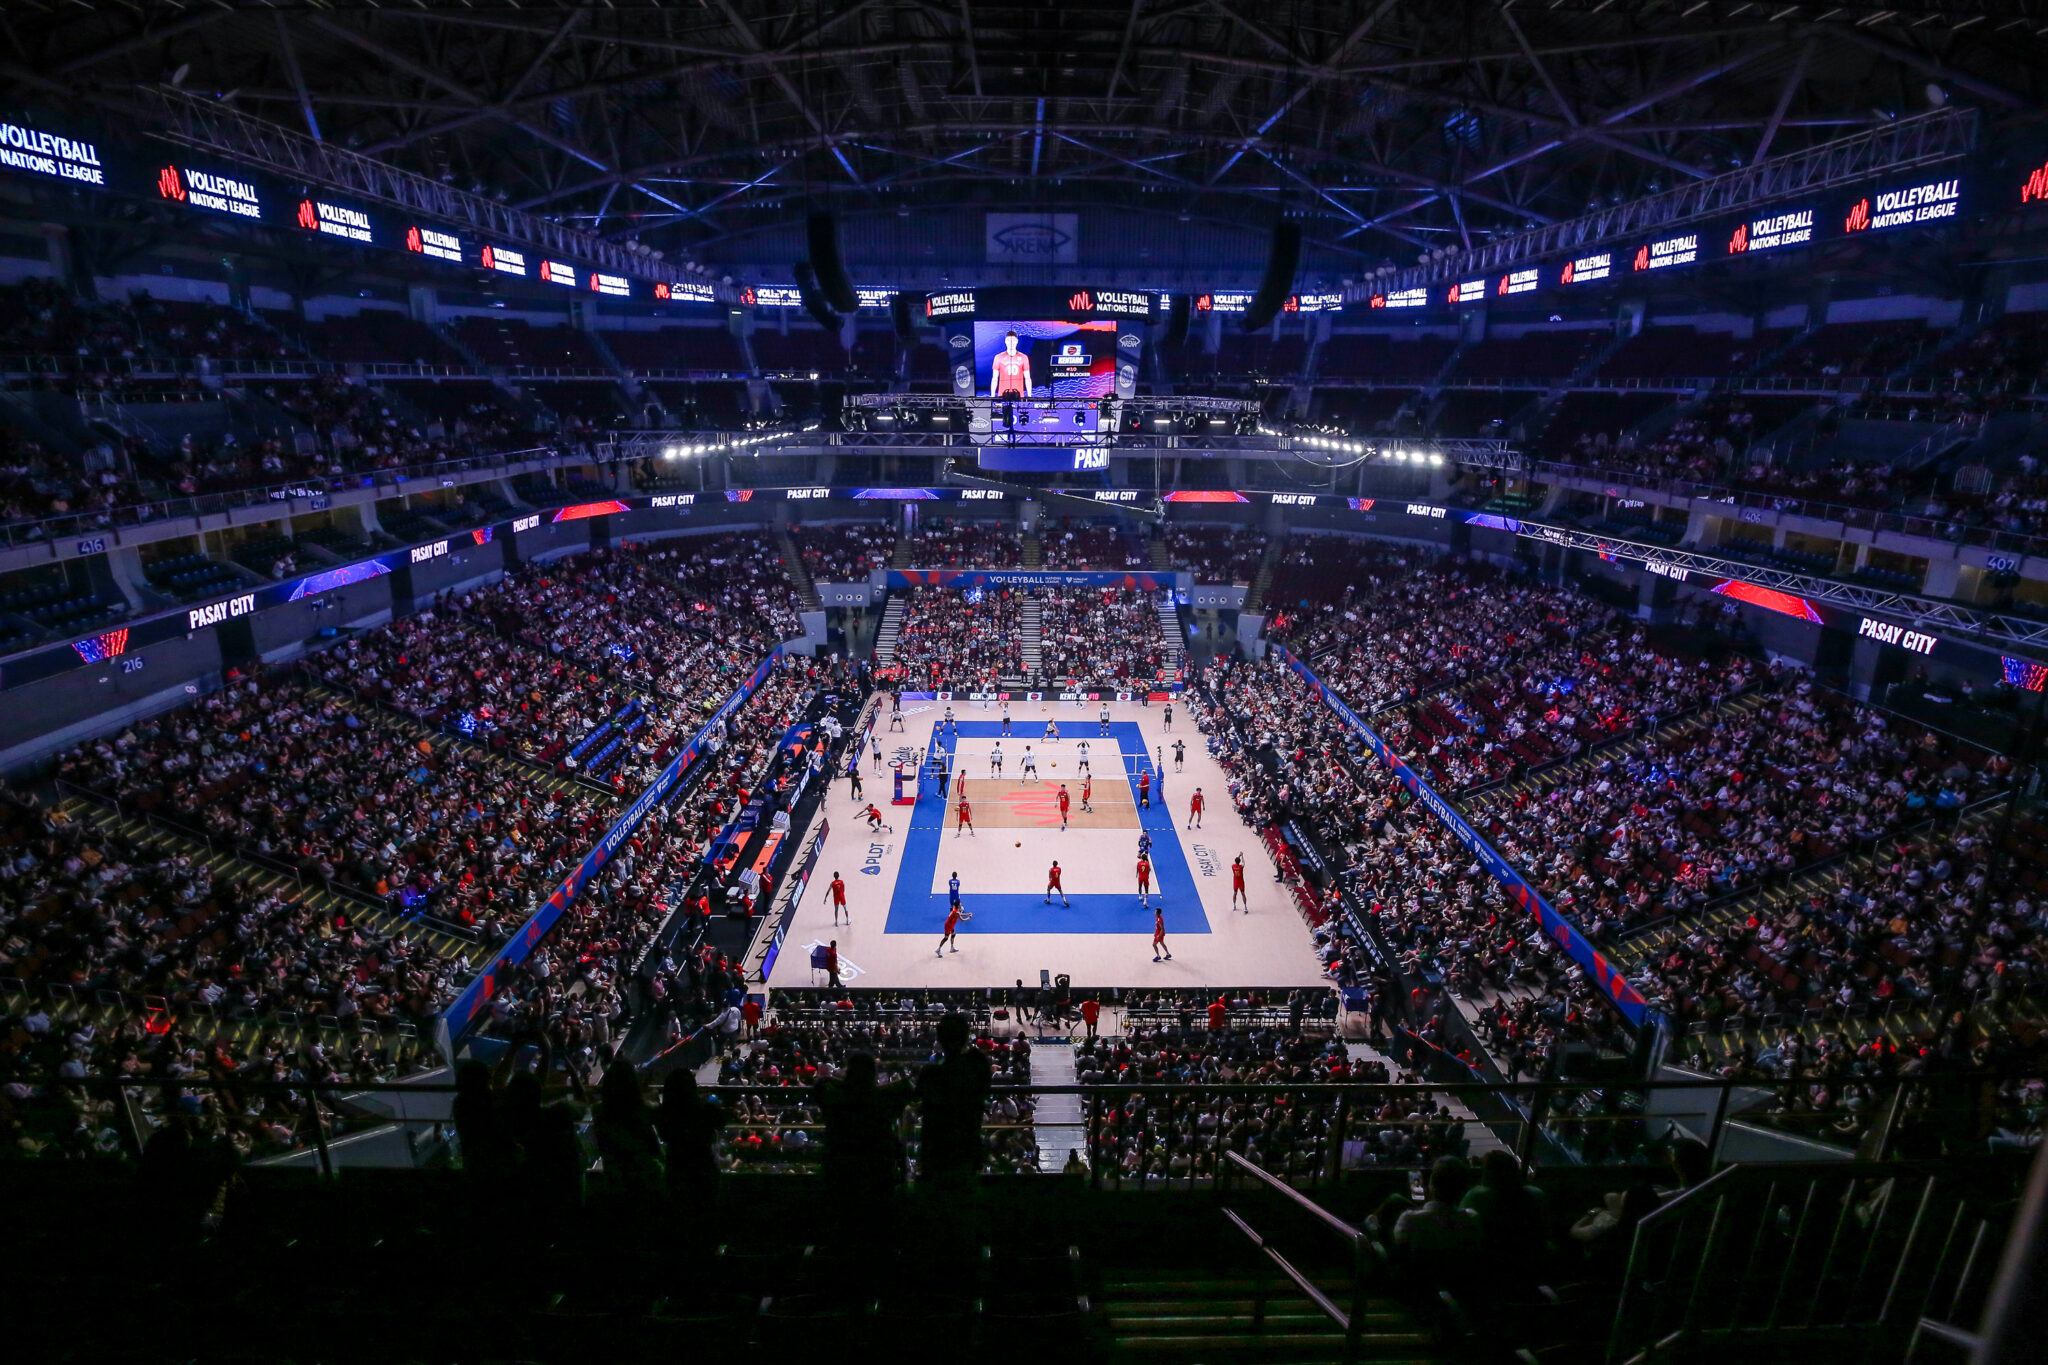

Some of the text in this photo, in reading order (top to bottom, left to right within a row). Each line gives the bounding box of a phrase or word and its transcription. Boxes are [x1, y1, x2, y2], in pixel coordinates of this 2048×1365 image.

[0, 123, 101, 166] VOLLEYBALL
[0, 148, 104, 185] NATIONS LEAGUE
[185, 169, 259, 202] VOLLEYBALL
[189, 191, 261, 218] NATIONS LEAGUE
[1876, 179, 1959, 213] VOLLEYBALL
[317, 202, 371, 229] VOLLEYBALL
[1752, 210, 1813, 237] VOLLEYBALL
[1871, 202, 1957, 229] NATIONS LEAGUE
[319, 221, 373, 242] NATIONS LEAGUE
[421, 229, 461, 251] VOLLEYBALL
[1749, 228, 1812, 251] NATIONS LEAGUE
[1652, 235, 1697, 256] VOLLEYBALL
[1575, 253, 1611, 272] VOLLEYBALL
[1649, 250, 1696, 269] NATIONS LEAGUE
[931, 292, 975, 306] VOLLEYBALL
[1096, 292, 1149, 306] VOLLEYBALL
[1096, 303, 1149, 315] NATIONS LEAGUE
[931, 304, 975, 315] NATIONS LEAGUE
[651, 494, 695, 508] PASAY CITY
[787, 488, 830, 500] PASAY CITY
[961, 489, 986, 500] PASAY
[1095, 490, 1138, 501] PASAY CITY
[1272, 494, 1316, 506] PASAY CITY
[1407, 504, 1447, 519] PASAY CITY
[1745, 512, 1761, 523] 406
[513, 515, 540, 533] PASAY CITY
[81, 539, 104, 553] 416
[411, 544, 432, 564] PASAY
[433, 540, 448, 557] CITY
[1988, 557, 2015, 570] 407
[990, 576, 1044, 584] VOLLEYBALL
[1669, 566, 1689, 582] CITY
[190, 593, 255, 629] PASAY CITY
[1859, 617, 1938, 656] PASAY CITY
[123, 657, 143, 673] 216
[1419, 784, 1457, 831] VOLLEYBALL
[606, 802, 646, 852] VOLLEYBALL
[866, 843, 885, 864] PLDT
[1191, 843, 1216, 877] PASAY CITY
